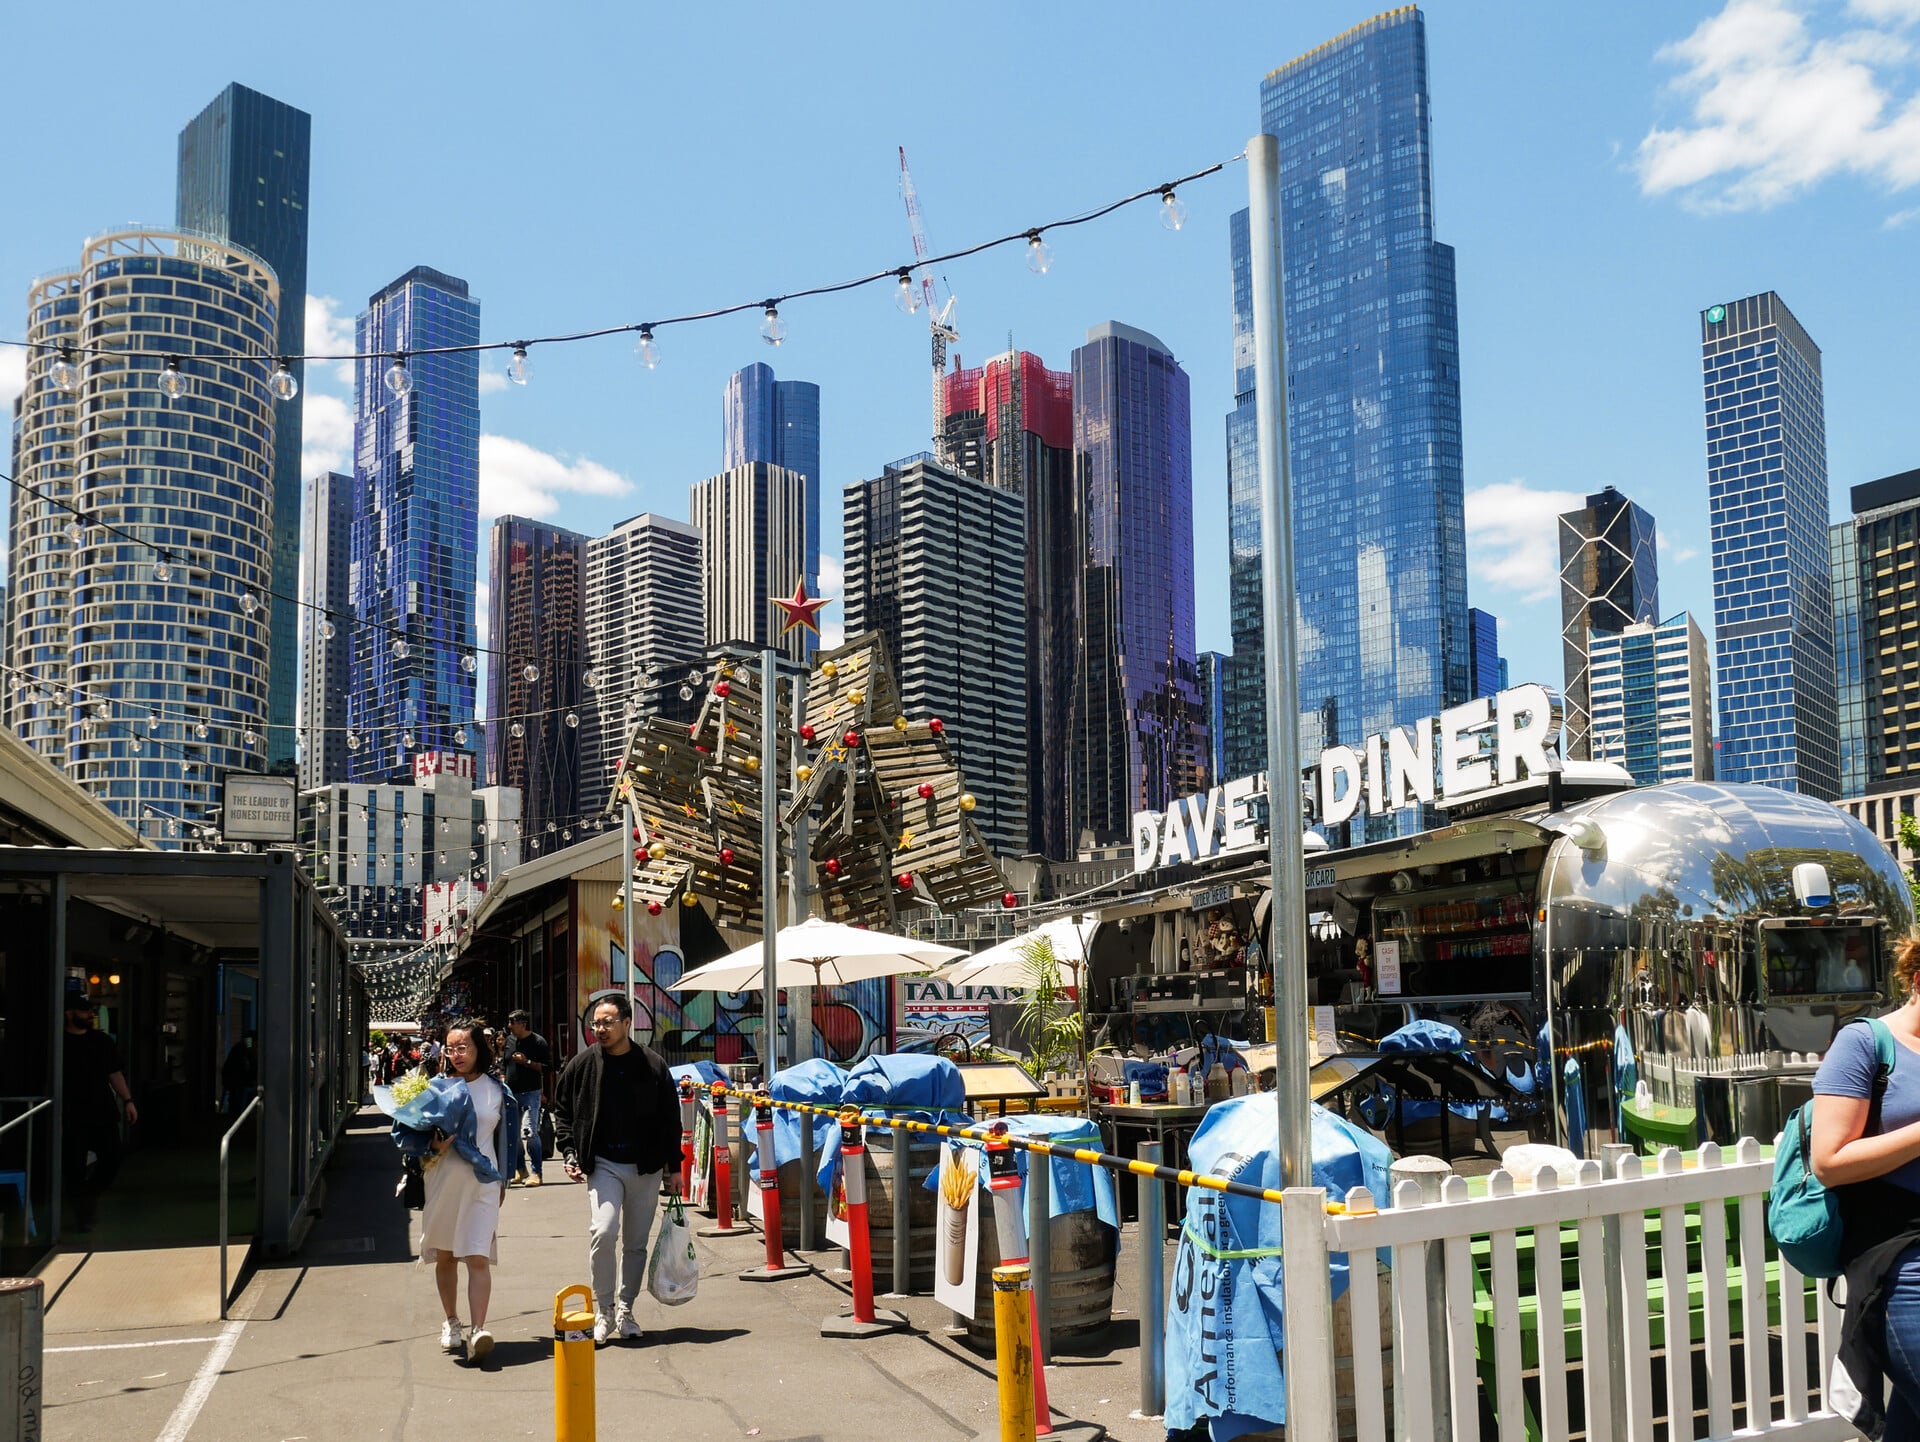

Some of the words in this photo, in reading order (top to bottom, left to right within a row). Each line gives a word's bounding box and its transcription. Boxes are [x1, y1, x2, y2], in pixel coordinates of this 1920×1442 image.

[1321, 683, 1564, 827] DINER
[233, 795, 247, 806] THE
[249, 796, 278, 808] LEAGUE
[280, 798, 290, 808] OF
[230, 809, 261, 820] HONEST
[263, 810, 291, 822] COFFEE
[1305, 871, 1315, 887] OR
[1315, 868, 1335, 886] CARD
[1193, 891, 1210, 908] ORDER
[1211, 886, 1228, 903] HERE
[1222, 1260, 1234, 1325] insulation
[1224, 1328, 1237, 1413] Performance
